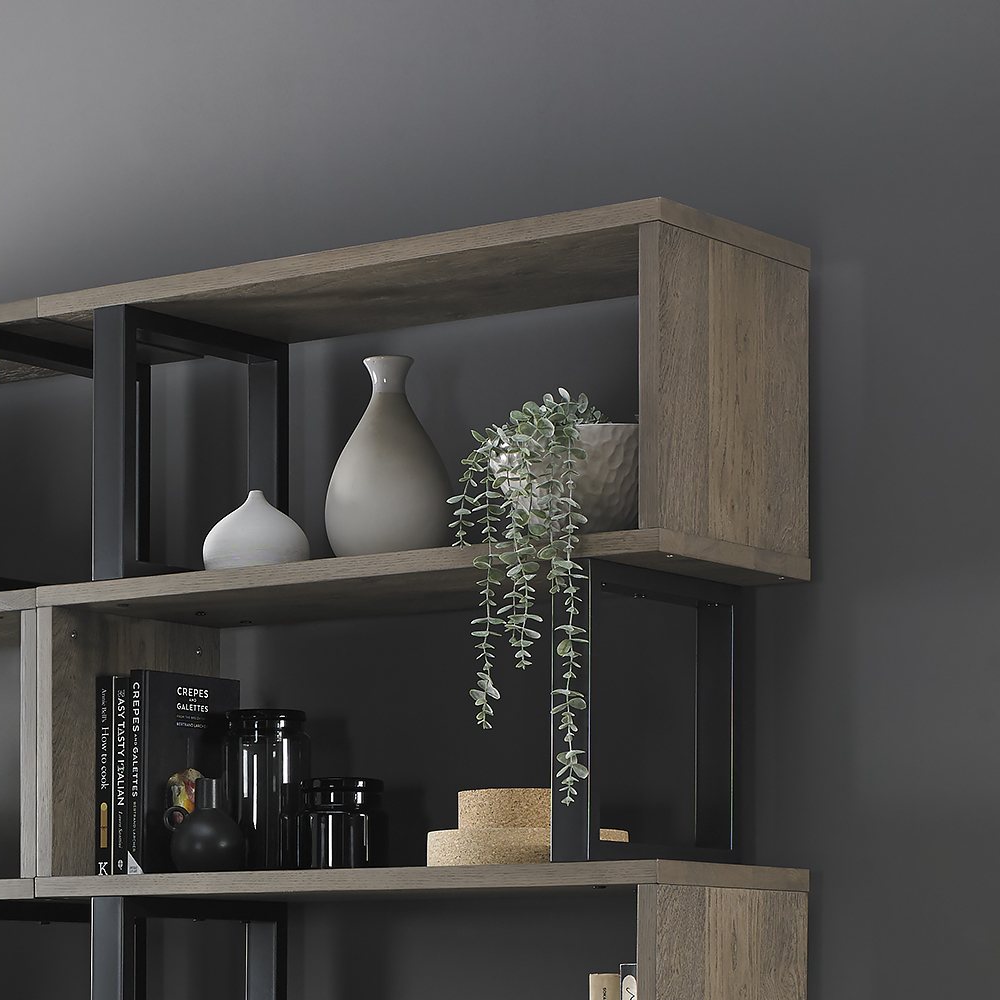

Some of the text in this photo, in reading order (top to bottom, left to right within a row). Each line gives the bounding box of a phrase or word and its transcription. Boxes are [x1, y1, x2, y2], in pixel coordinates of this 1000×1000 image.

[177, 687, 209, 698] CREPES
[132, 682, 140, 732] CREPES
[176, 702, 209, 713] GALETTES
[100, 727, 109, 751] How
[117, 689, 126, 806] EASY TASTY ITALIAN
[100, 753, 109, 764] to
[100, 766, 110, 790] cook
[98, 862, 108, 876] K
